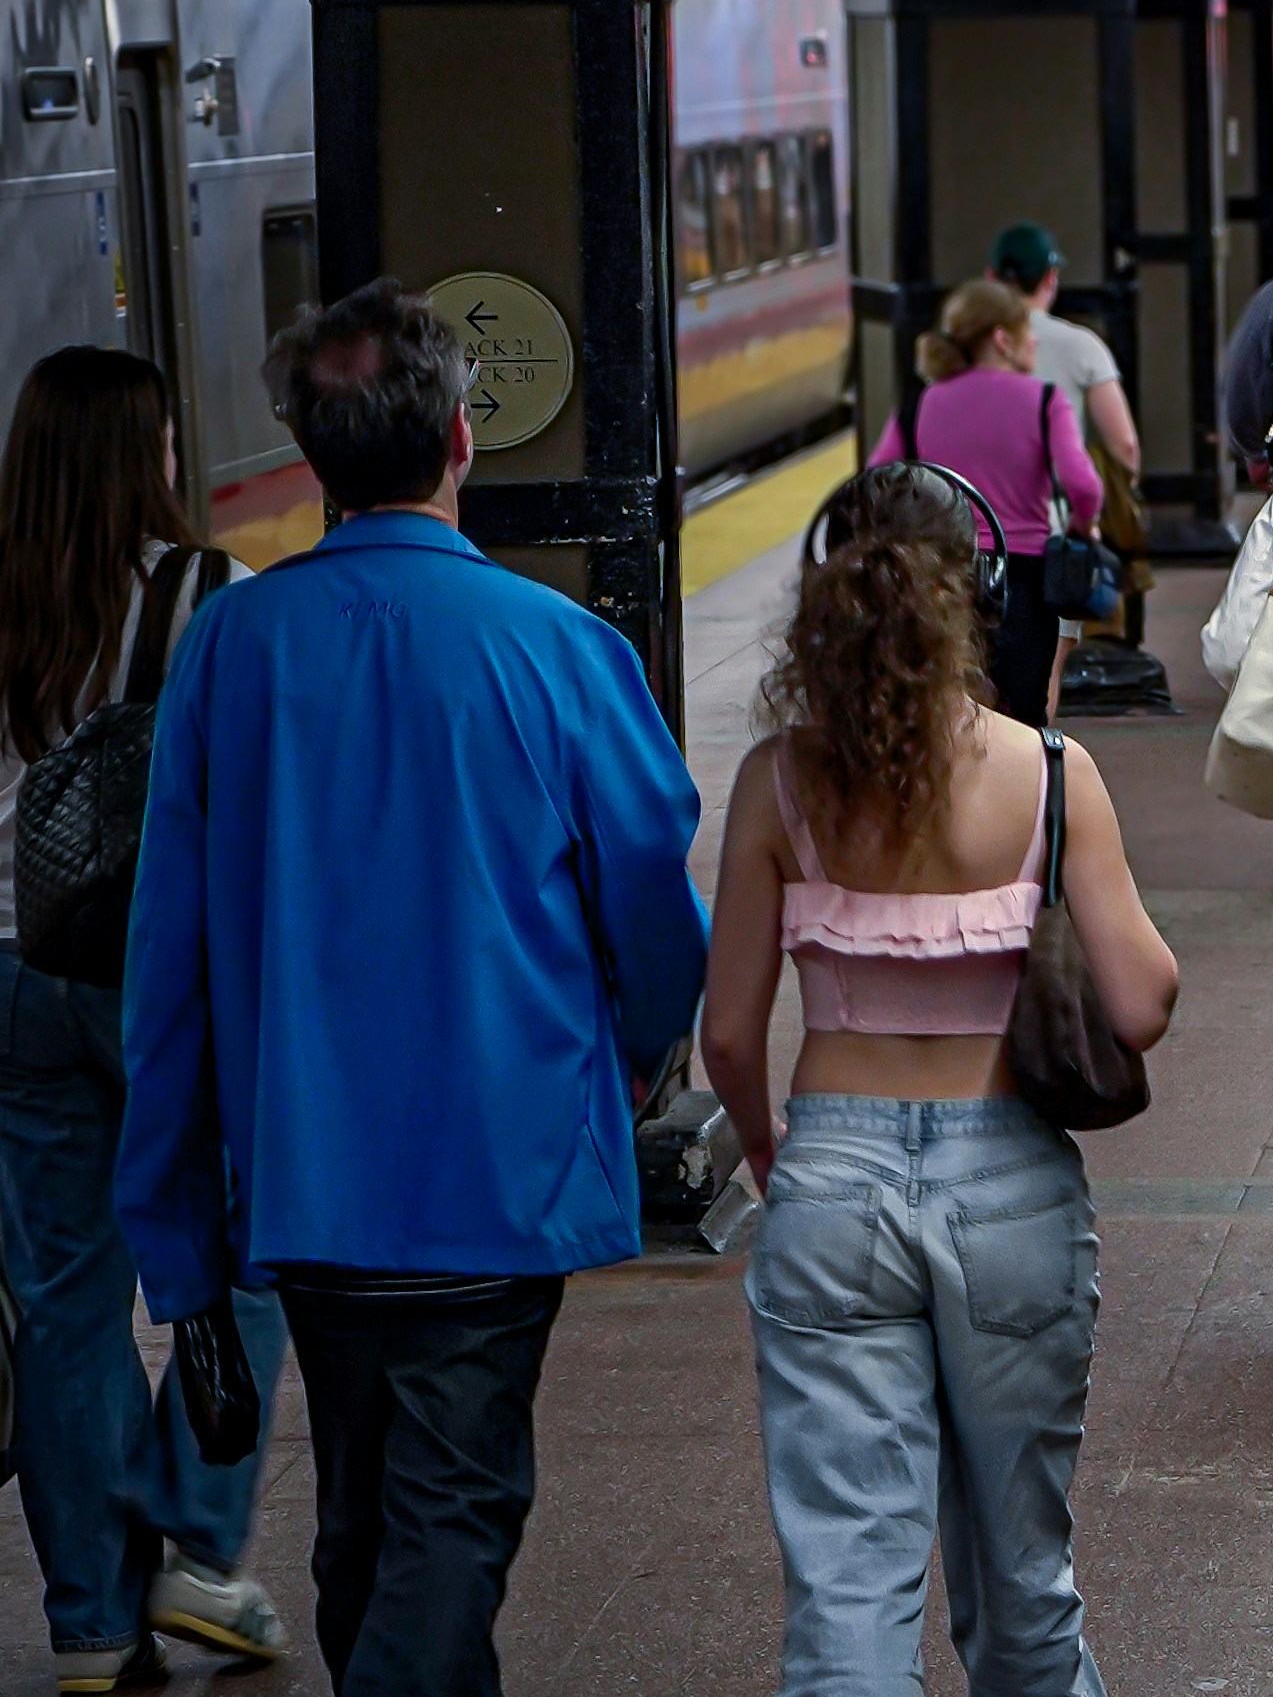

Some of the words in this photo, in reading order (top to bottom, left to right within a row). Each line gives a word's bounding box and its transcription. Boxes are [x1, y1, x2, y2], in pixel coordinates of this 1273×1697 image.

[465, 338, 509, 356] ACK
[514, 338, 534, 356] 21
[476, 366, 509, 383] CK
[513, 366, 536, 383] 20
